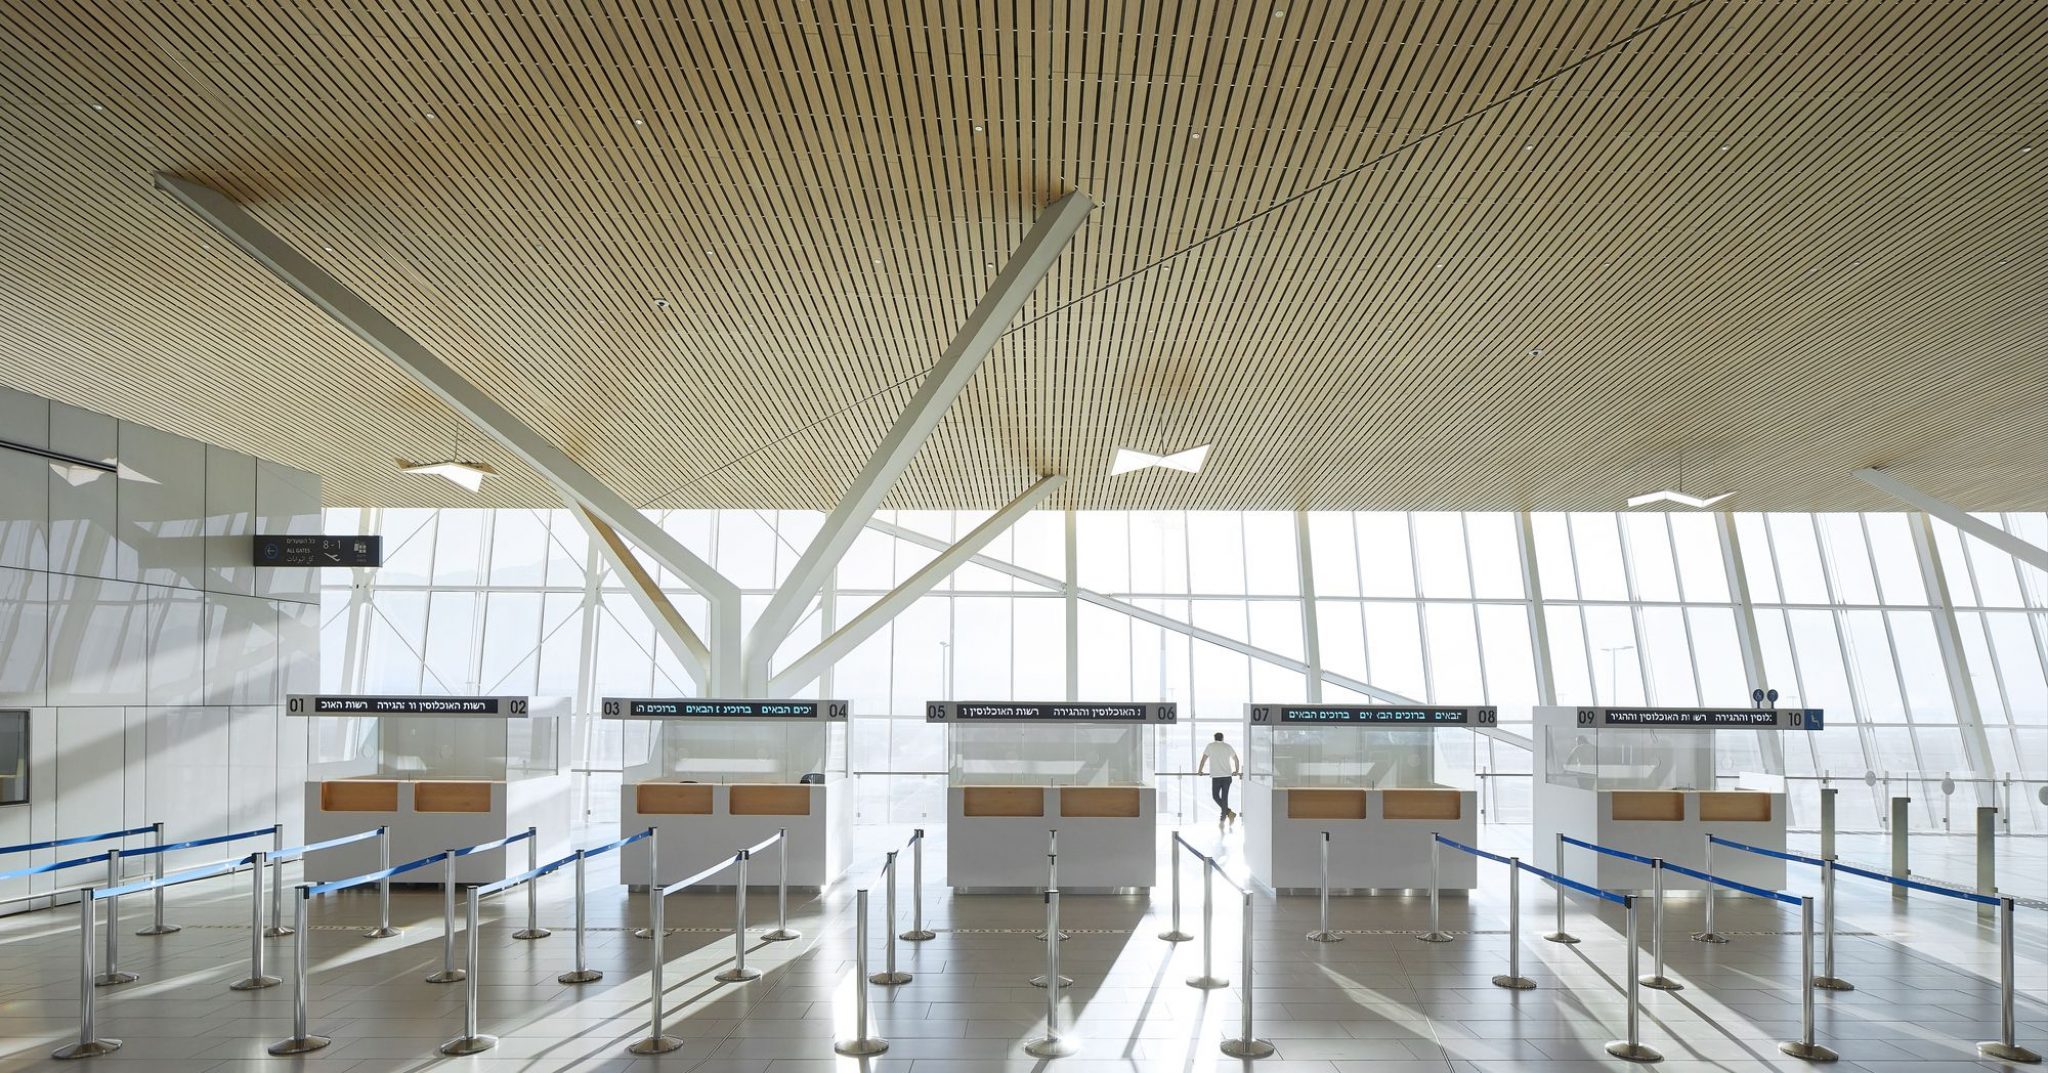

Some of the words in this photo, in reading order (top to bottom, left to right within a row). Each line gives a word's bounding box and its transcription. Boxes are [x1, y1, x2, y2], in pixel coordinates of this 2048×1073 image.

[290, 698, 304, 712] 01
[345, 701, 368, 709] רשות
[419, 701, 461, 712] האוכלוסין
[463, 702, 486, 710] רשות
[510, 700, 526, 714] 02
[604, 702, 620, 715] 03
[647, 705, 677, 713] ברוכים
[686, 705, 714, 713] הבאים
[762, 706, 790, 714] הבאים
[829, 704, 847, 717] 04
[928, 705, 945, 719] 05
[970, 706, 1013, 717] האוכלוסין
[1016, 708, 1039, 716] רשות
[1053, 708, 1089, 716] וההגירה
[1092, 707, 1135, 718] האוכלוסין
[1158, 706, 1175, 720] 06
[1253, 708, 1269, 722] 07
[1289, 711, 1317, 719] הבאים
[1320, 711, 1350, 719] ברוכים
[1395, 711, 1426, 719] ברוכים
[1479, 710, 1495, 723] 08
[1639, 712, 1679, 722] האוכלוסין
[1579, 711, 1595, 724] 09
[1788, 712, 1802, 726] 10
